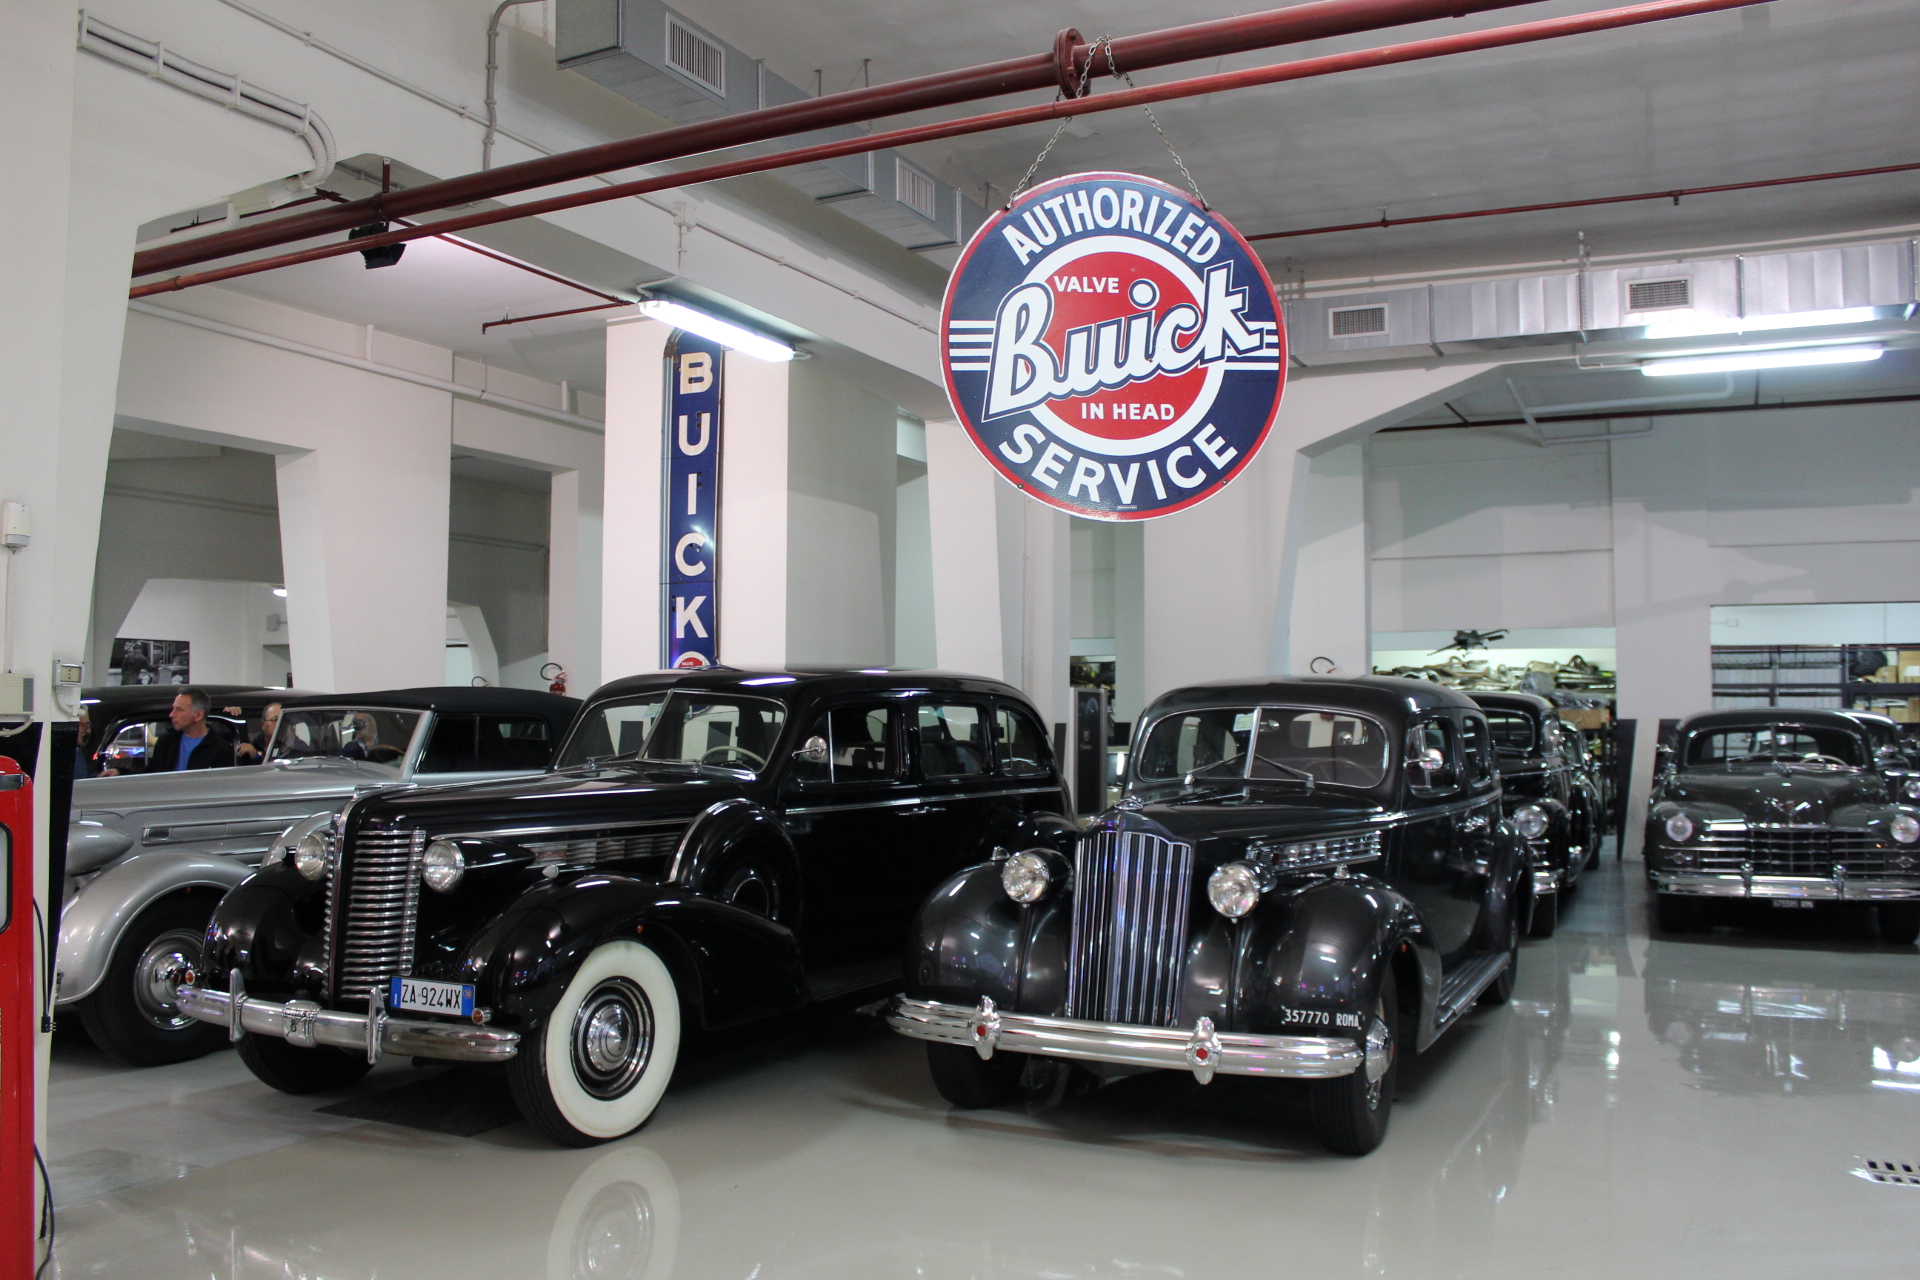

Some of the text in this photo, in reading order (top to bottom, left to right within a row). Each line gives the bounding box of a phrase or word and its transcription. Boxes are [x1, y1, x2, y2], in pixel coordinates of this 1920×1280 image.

[1002, 187, 1221, 266] AUTHORIZED
[1054, 275, 1119, 294] VALVE
[982, 260, 1266, 423] Buick
[1081, 403, 1175, 420] IN HEAD
[675, 351, 714, 638] BUICK
[998, 423, 1238, 504] SERVICE
[1284, 1008, 1359, 1027] 357770 ROMA
